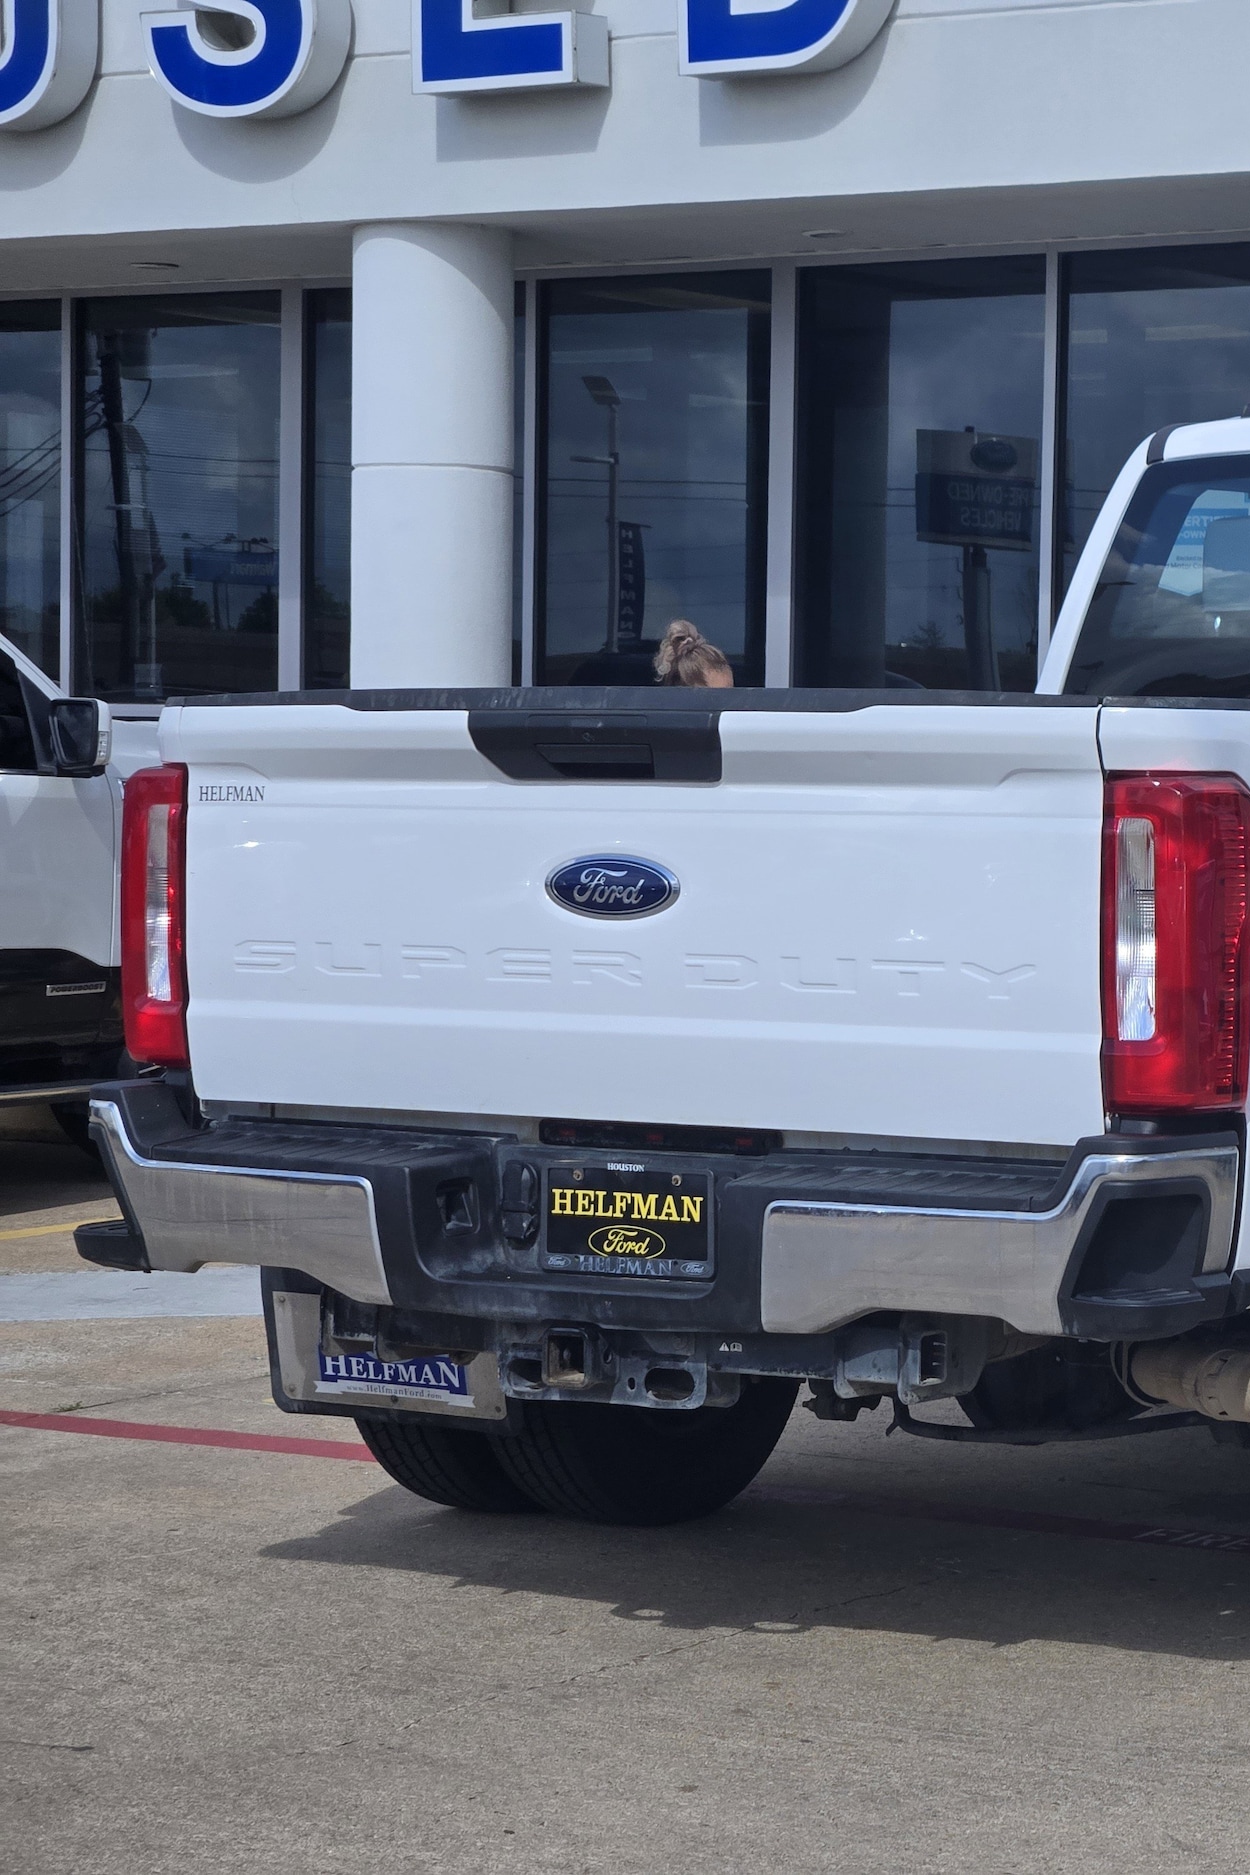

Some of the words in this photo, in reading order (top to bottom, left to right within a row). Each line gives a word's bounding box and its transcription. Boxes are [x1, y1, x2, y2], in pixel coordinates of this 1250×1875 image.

[199, 785, 265, 801] HELFMAN
[573, 867, 645, 904] Ford
[233, 939, 643, 988] SUPER
[685, 953, 1036, 1000] DUTY
[607, 1163, 645, 1172] HOUSTON
[551, 1188, 703, 1223] HELFMAN
[603, 1228, 650, 1255] Ford
[579, 1255, 674, 1276] HELFMAN
[324, 1354, 460, 1388] HELFMAN
